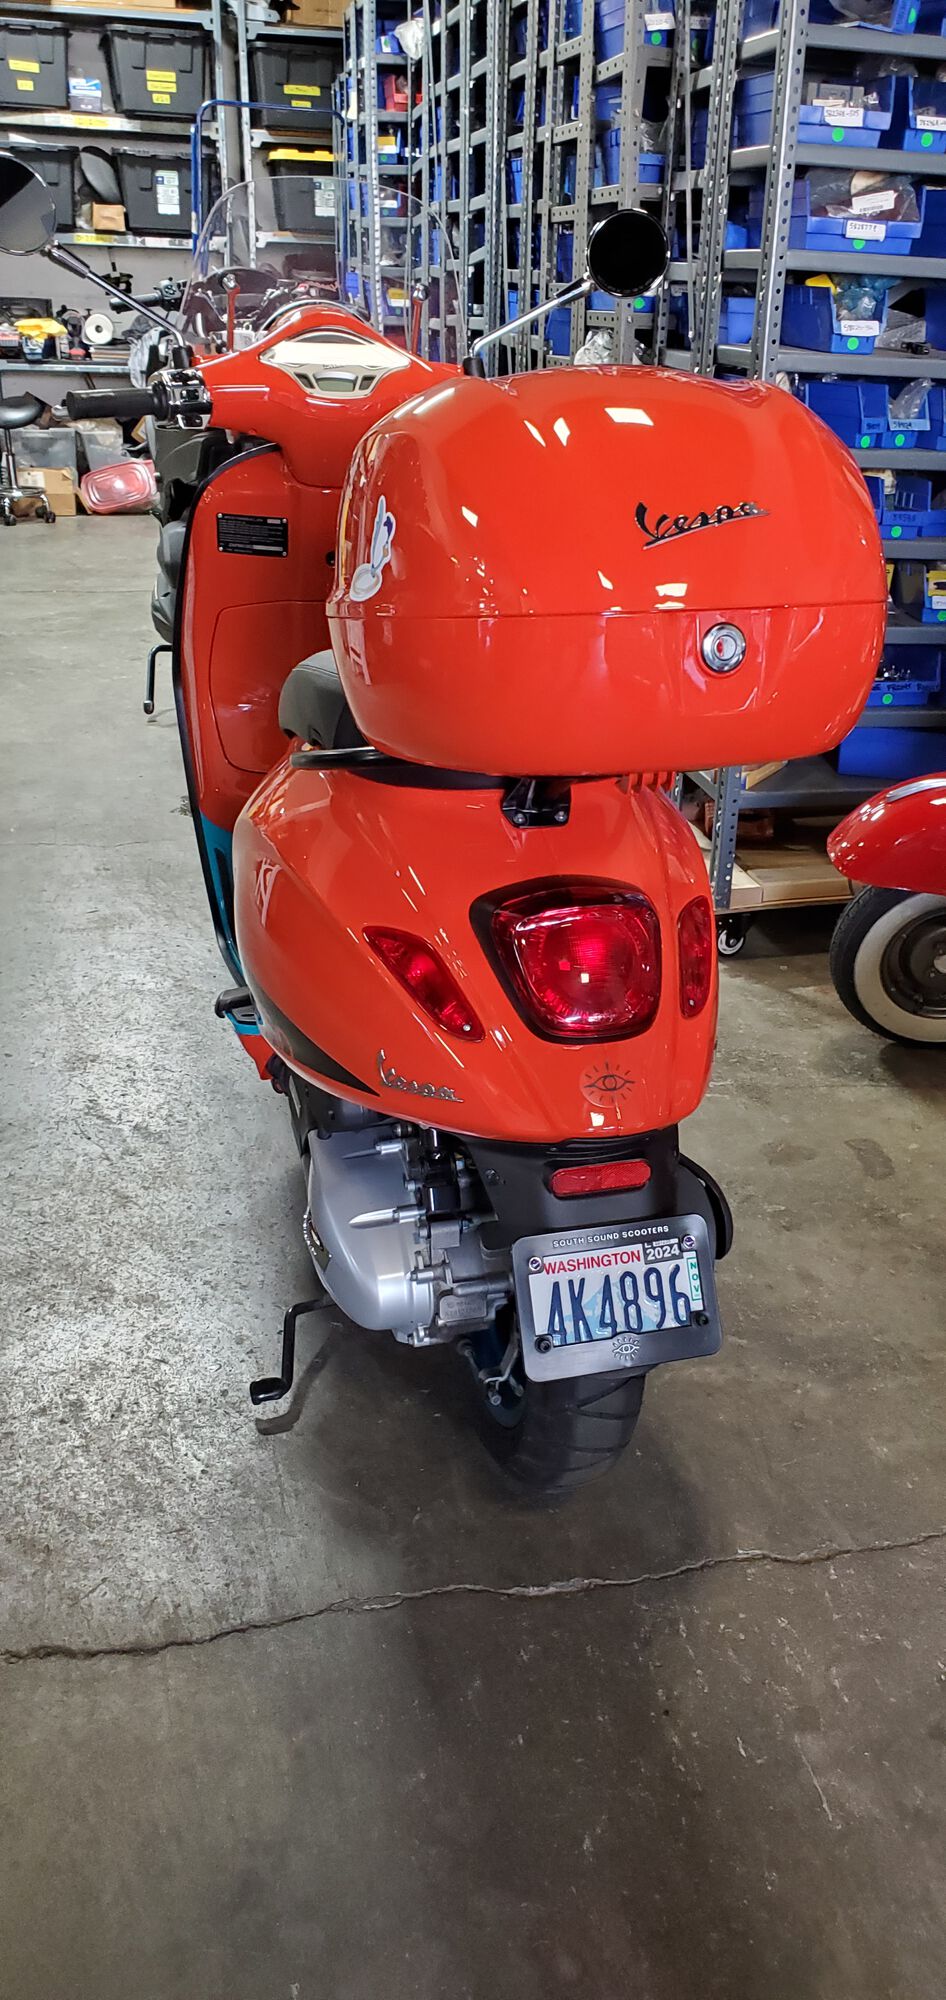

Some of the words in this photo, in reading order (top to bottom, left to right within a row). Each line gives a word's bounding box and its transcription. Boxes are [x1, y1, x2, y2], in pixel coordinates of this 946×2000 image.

[634, 500, 769, 550] Vespa
[377, 1048, 464, 1102] Vespa
[553, 1237, 584, 1248] SOUTH
[588, 1231, 619, 1243] SOUND
[622, 1225, 669, 1238] SCOOTERS
[646, 1244, 680, 1260] 2024
[543, 1250, 641, 1275] WASHINGTON
[690, 1261, 700, 1293] NOV
[547, 1264, 691, 1345] AK4896
